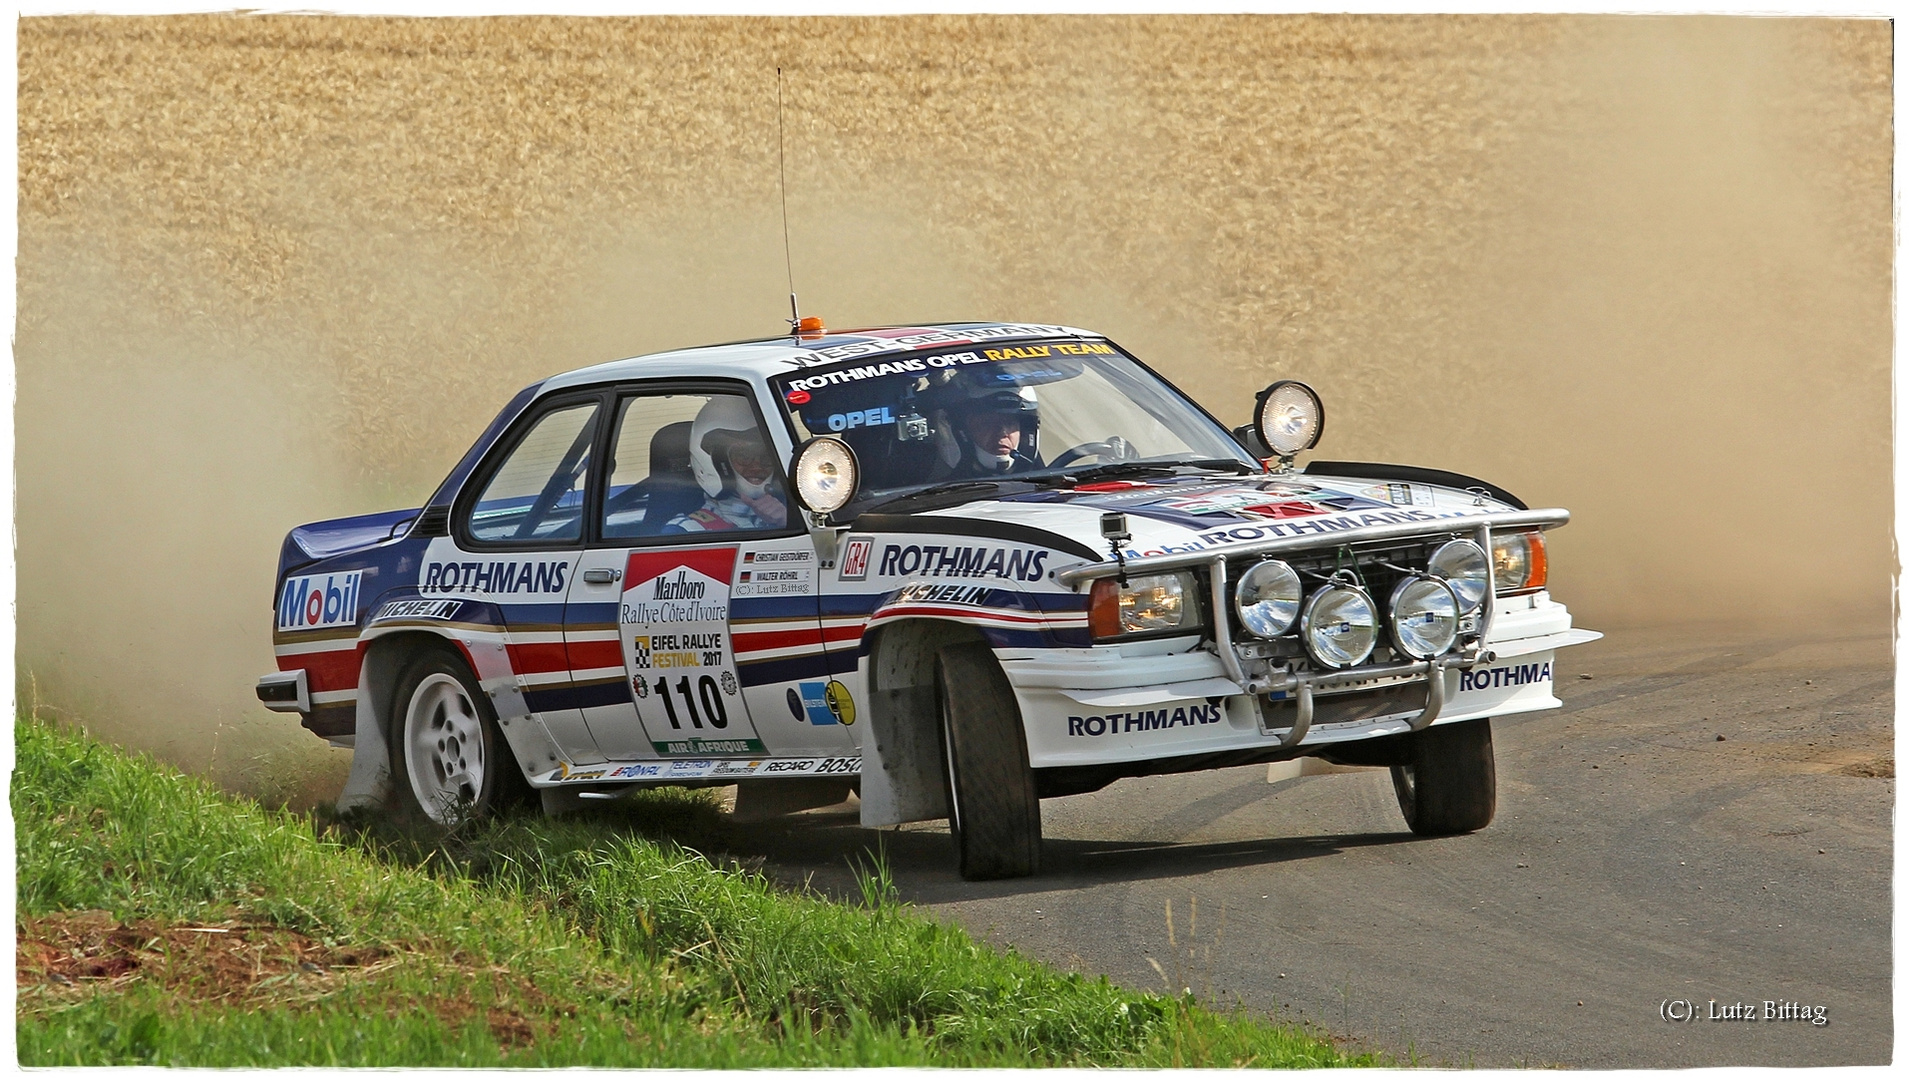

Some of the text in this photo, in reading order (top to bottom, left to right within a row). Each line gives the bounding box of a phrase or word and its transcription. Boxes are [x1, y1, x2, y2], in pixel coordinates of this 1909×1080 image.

[789, 344, 1116, 392] ROTHMANS OPEL RALLY TEAM
[828, 407, 896, 432] OPEL
[1200, 510, 1436, 545] ROTHMANS
[423, 561, 568, 594] ROTHMANS
[757, 571, 778, 581] WALTER
[879, 545, 1048, 581] ROTHMANS
[281, 573, 361, 627] Mobil
[653, 571, 705, 600] Marlboro
[621, 600, 726, 629] Rallye Côte d'Ivoire
[652, 634, 721, 650] EIFEL RALLYE
[652, 651, 722, 668] FESTIVAL 2017
[653, 675, 728, 729] 110
[1068, 704, 1221, 736] ROTHMANS
[667, 741, 749, 753] AIR AFRIQUE
[619, 766, 661, 778] RONAL
[765, 761, 815, 772] RECARO
